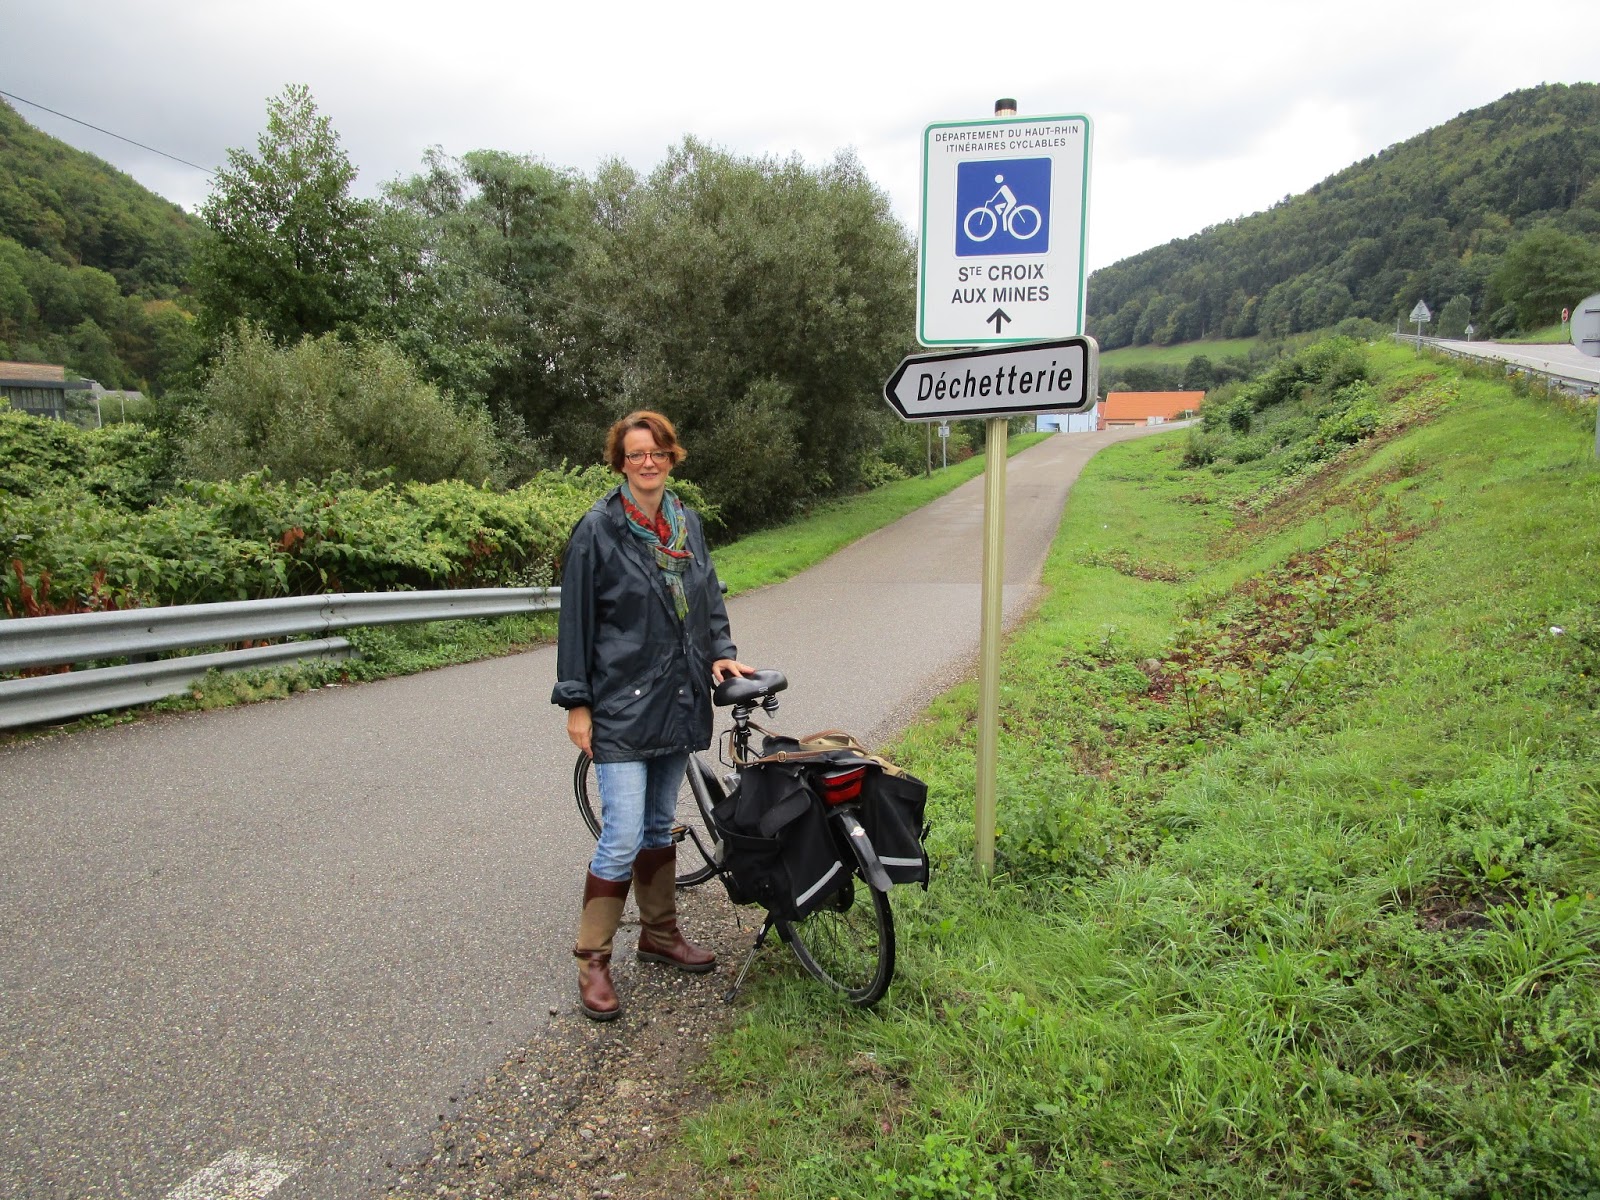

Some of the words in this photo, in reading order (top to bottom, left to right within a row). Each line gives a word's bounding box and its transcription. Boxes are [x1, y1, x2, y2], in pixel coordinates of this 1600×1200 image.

[935, 130, 1004, 142] DÉPARTEMENT
[1008, 128, 1021, 137] DU
[1025, 125, 1079, 136] HAUT-RHIN
[946, 141, 1006, 153] ITINÉRAIRES
[1009, 138, 1066, 149] CYCLABLES
[958, 266, 982, 282] STE
[988, 264, 1044, 281] CROIX
[951, 288, 987, 304] AUX
[992, 286, 1049, 303] MINES
[917, 360, 1073, 401] Déchetterie
